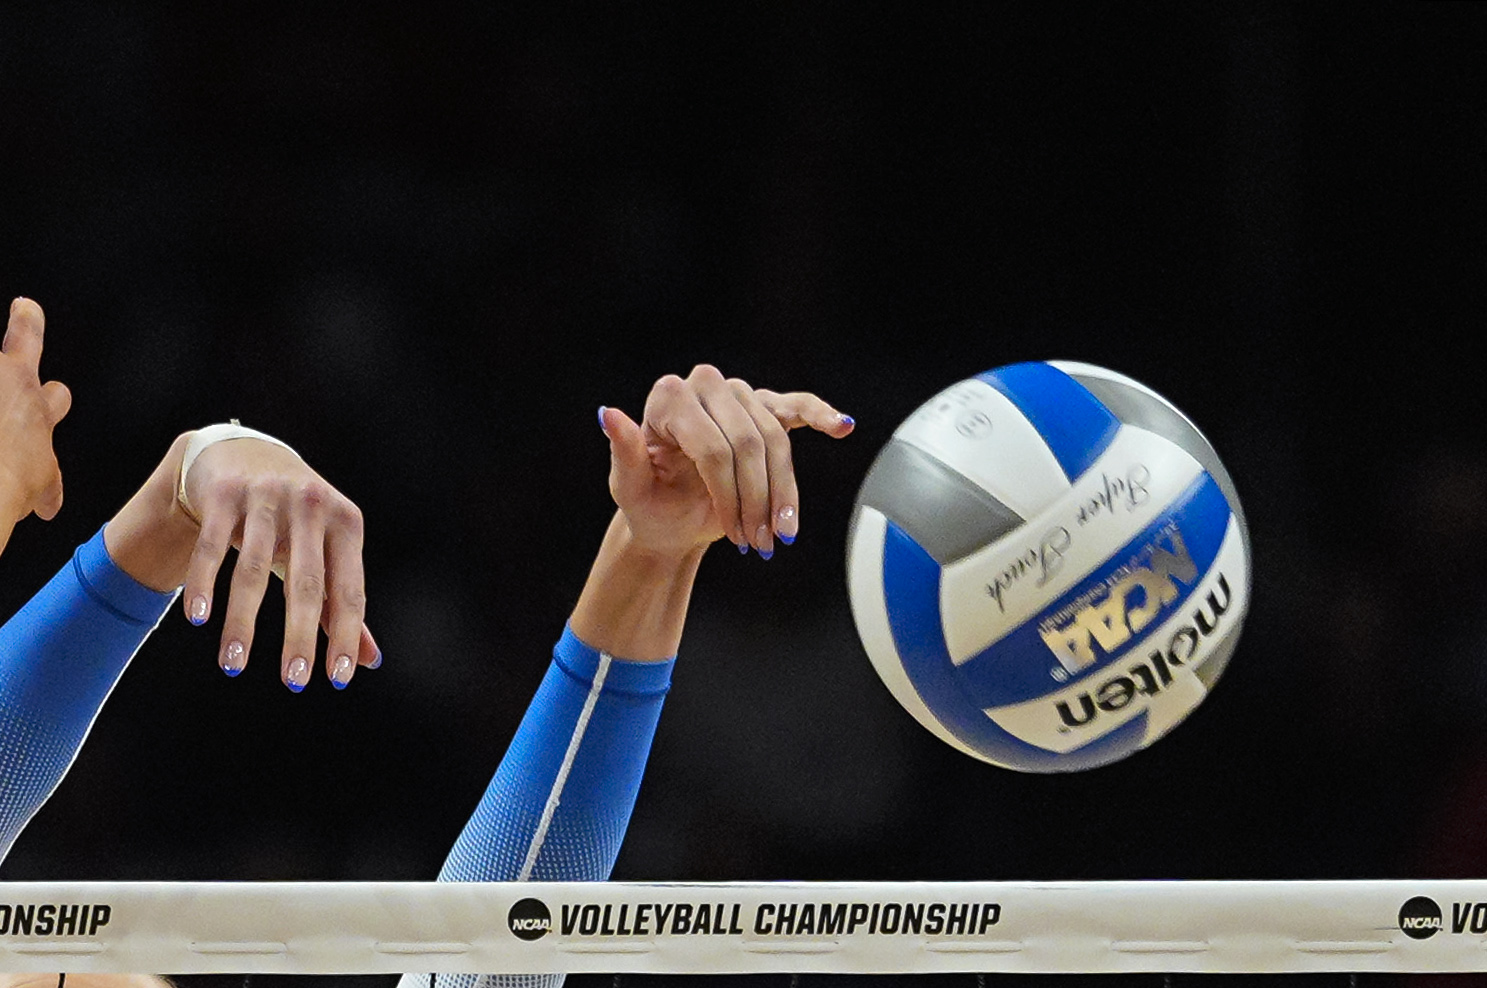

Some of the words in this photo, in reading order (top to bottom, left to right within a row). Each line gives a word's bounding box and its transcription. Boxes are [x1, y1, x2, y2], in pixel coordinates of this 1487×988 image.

[1077, 463, 1151, 527] Super
[985, 526, 1071, 614] Touch
[1038, 529, 1199, 677] NCAA
[1055, 571, 1232, 727] molten
[511, 917, 552, 931] NCAA
[561, 903, 743, 935] VOLLEYBALL
[754, 903, 1002, 936] CHAMPIONSHIP
[1402, 917, 1442, 929] NCAA
